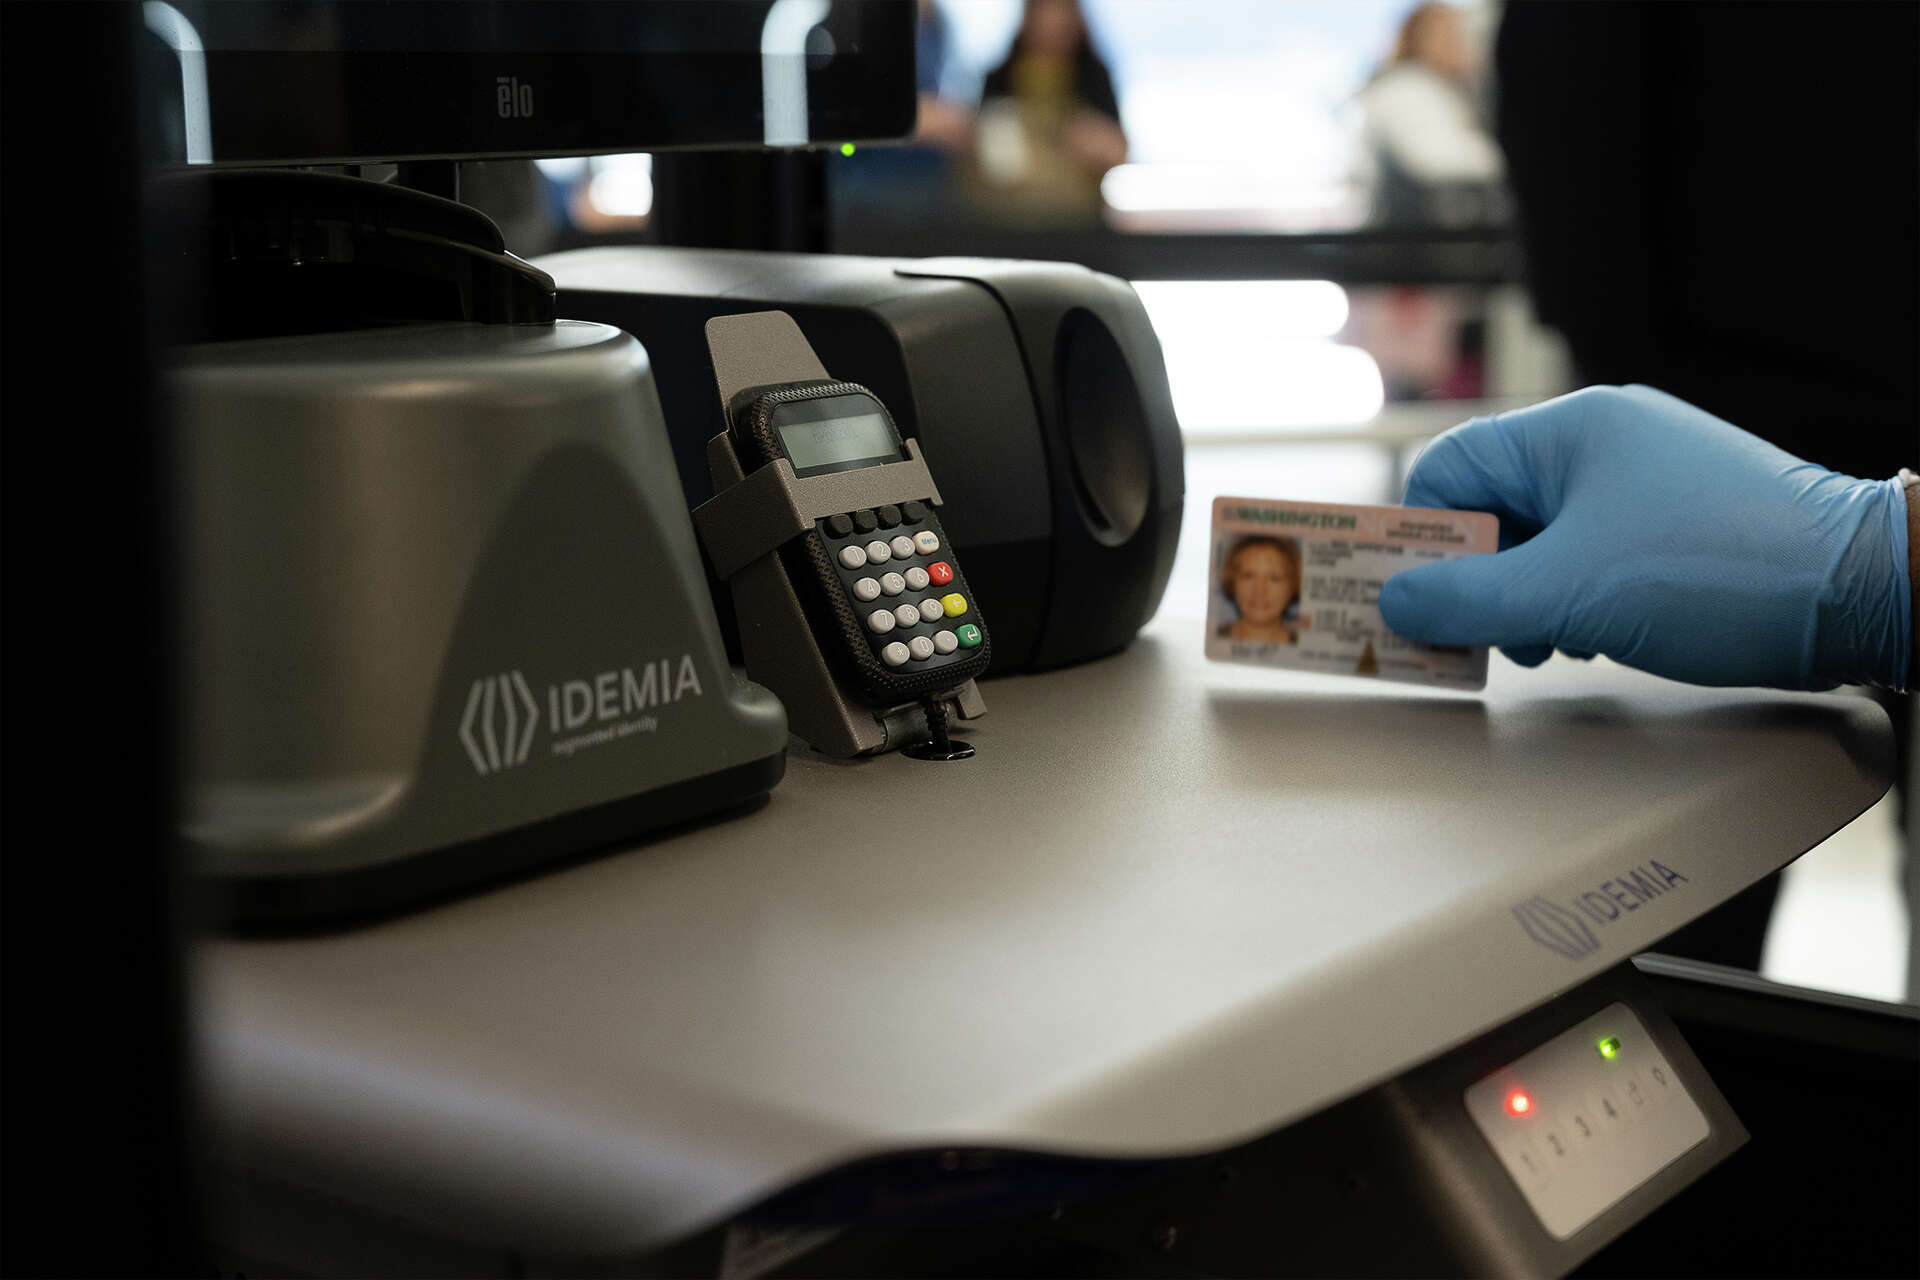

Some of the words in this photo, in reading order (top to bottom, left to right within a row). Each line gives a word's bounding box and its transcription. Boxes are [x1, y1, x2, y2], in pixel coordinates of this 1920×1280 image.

[1237, 507, 1357, 531] WASHINGTON
[920, 537, 938, 545] Menu
[548, 654, 703, 734] IDEMIA
[617, 714, 658, 737] identity
[1572, 859, 1689, 925] IDEMIA
